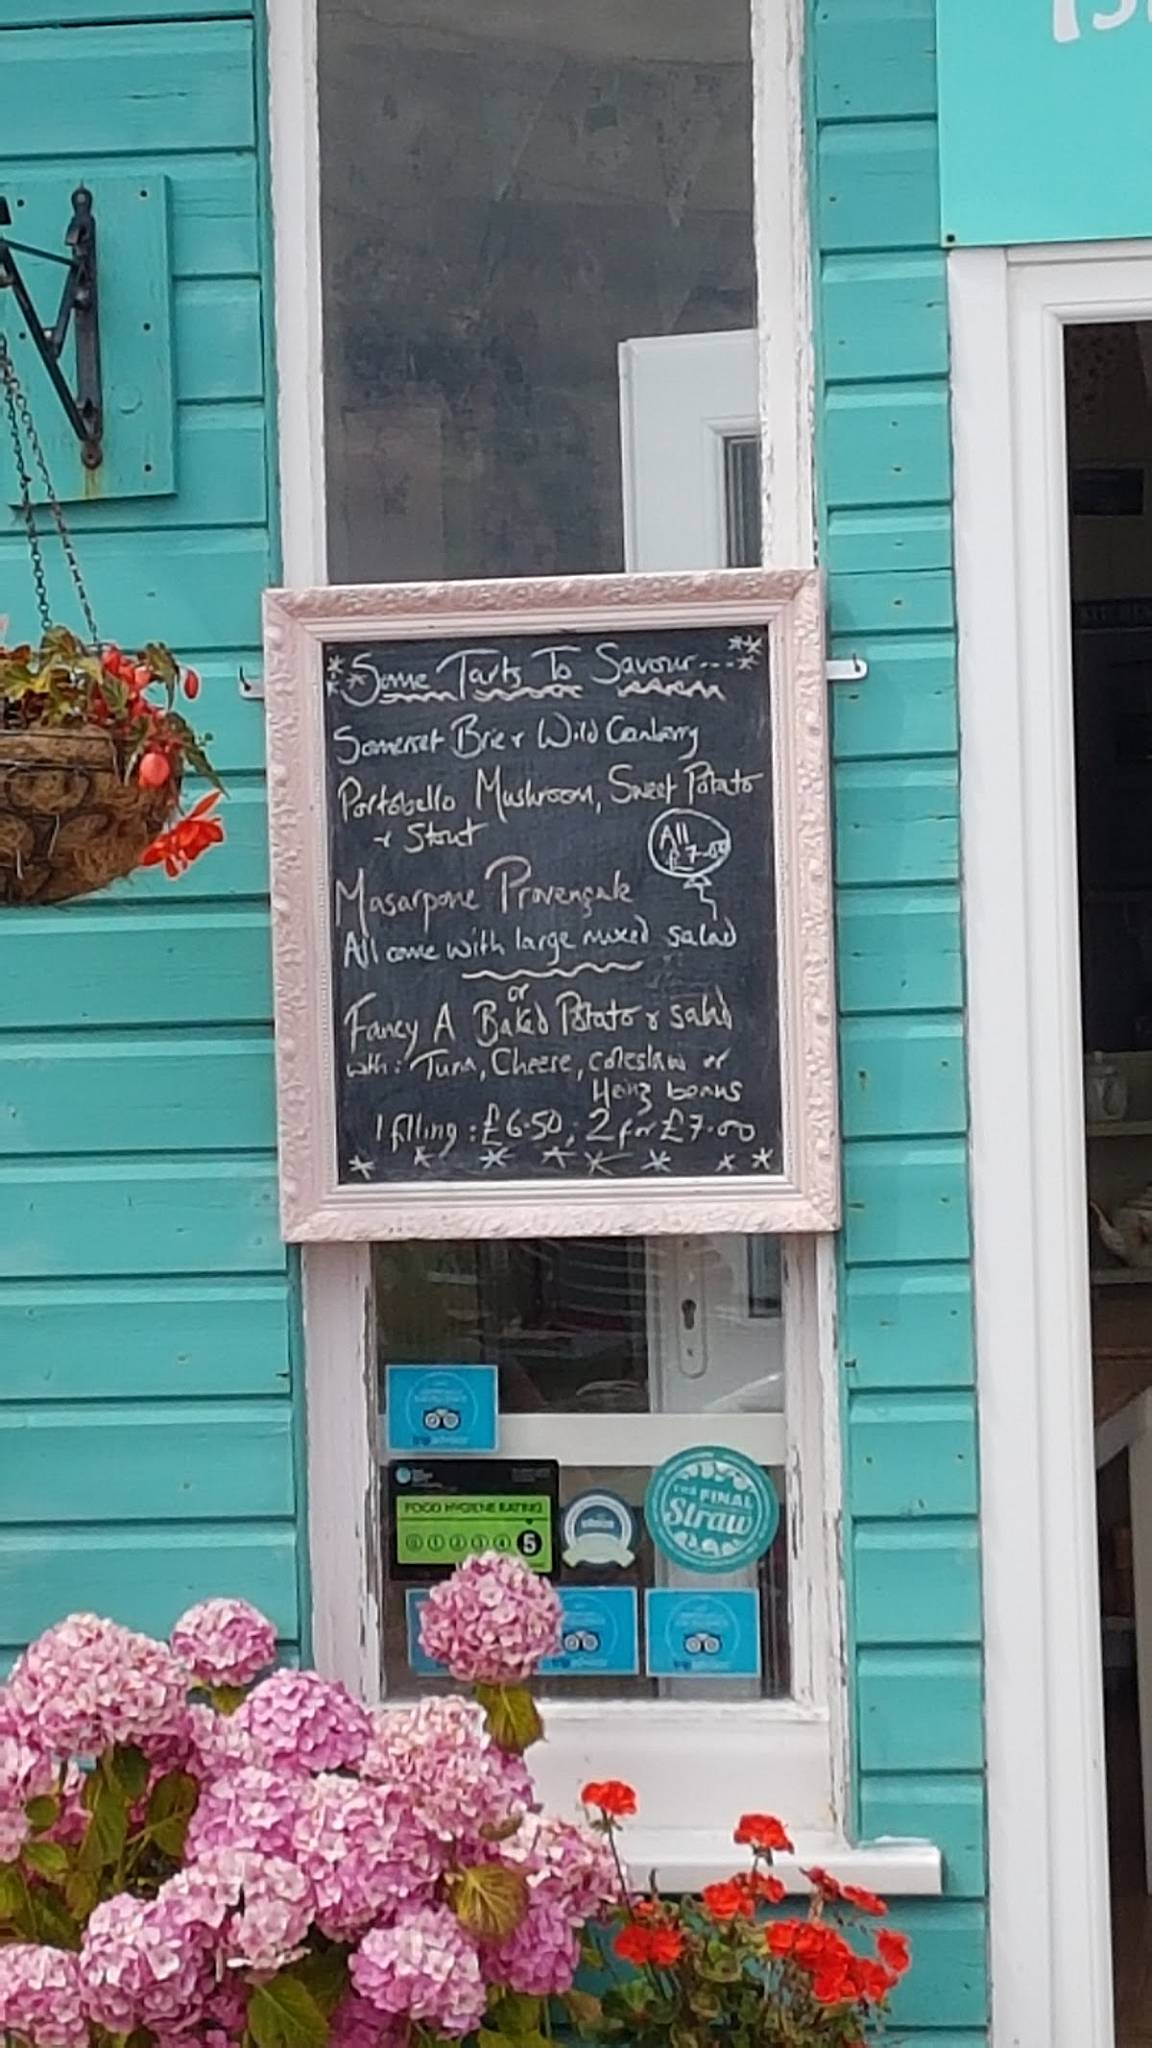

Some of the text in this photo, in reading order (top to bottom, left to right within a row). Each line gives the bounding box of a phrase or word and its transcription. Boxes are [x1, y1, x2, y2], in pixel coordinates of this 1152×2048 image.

[341, 652, 431, 706] Some
[436, 648, 522, 700] Tarts
[531, 645, 582, 681] To
[333, 725, 446, 765] Somerset
[450, 713, 507, 760] Brie
[537, 712, 598, 749] Wild
[337, 776, 456, 823] Portobello
[608, 763, 678, 804] Sweet
[682, 760, 764, 806] Potato
[403, 816, 489, 853] Stout
[659, 821, 690, 852] All
[343, 931, 379, 970] All
[446, 927, 506, 959] with
[515, 926, 577, 967] large
[582, 914, 649, 946] mixed
[665, 916, 737, 948] salad
[507, 982, 530, 1003] or
[343, 991, 420, 1061] Fancy
[433, 1001, 456, 1044] A
[472, 998, 549, 1047] Baked
[555, 990, 643, 1036] Potato
[669, 984, 733, 1031] salad
[702, 1048, 732, 1070] or
[666, 1080, 744, 1102] beans
[585, 1107, 616, 1143] 2
[444, 1502, 496, 1514] HYGIENE
[499, 1502, 543, 1514] RATING
[663, 1496, 753, 1537] Straw
[699, 1487, 754, 1510] FINAL
[522, 1533, 537, 1555] 5
